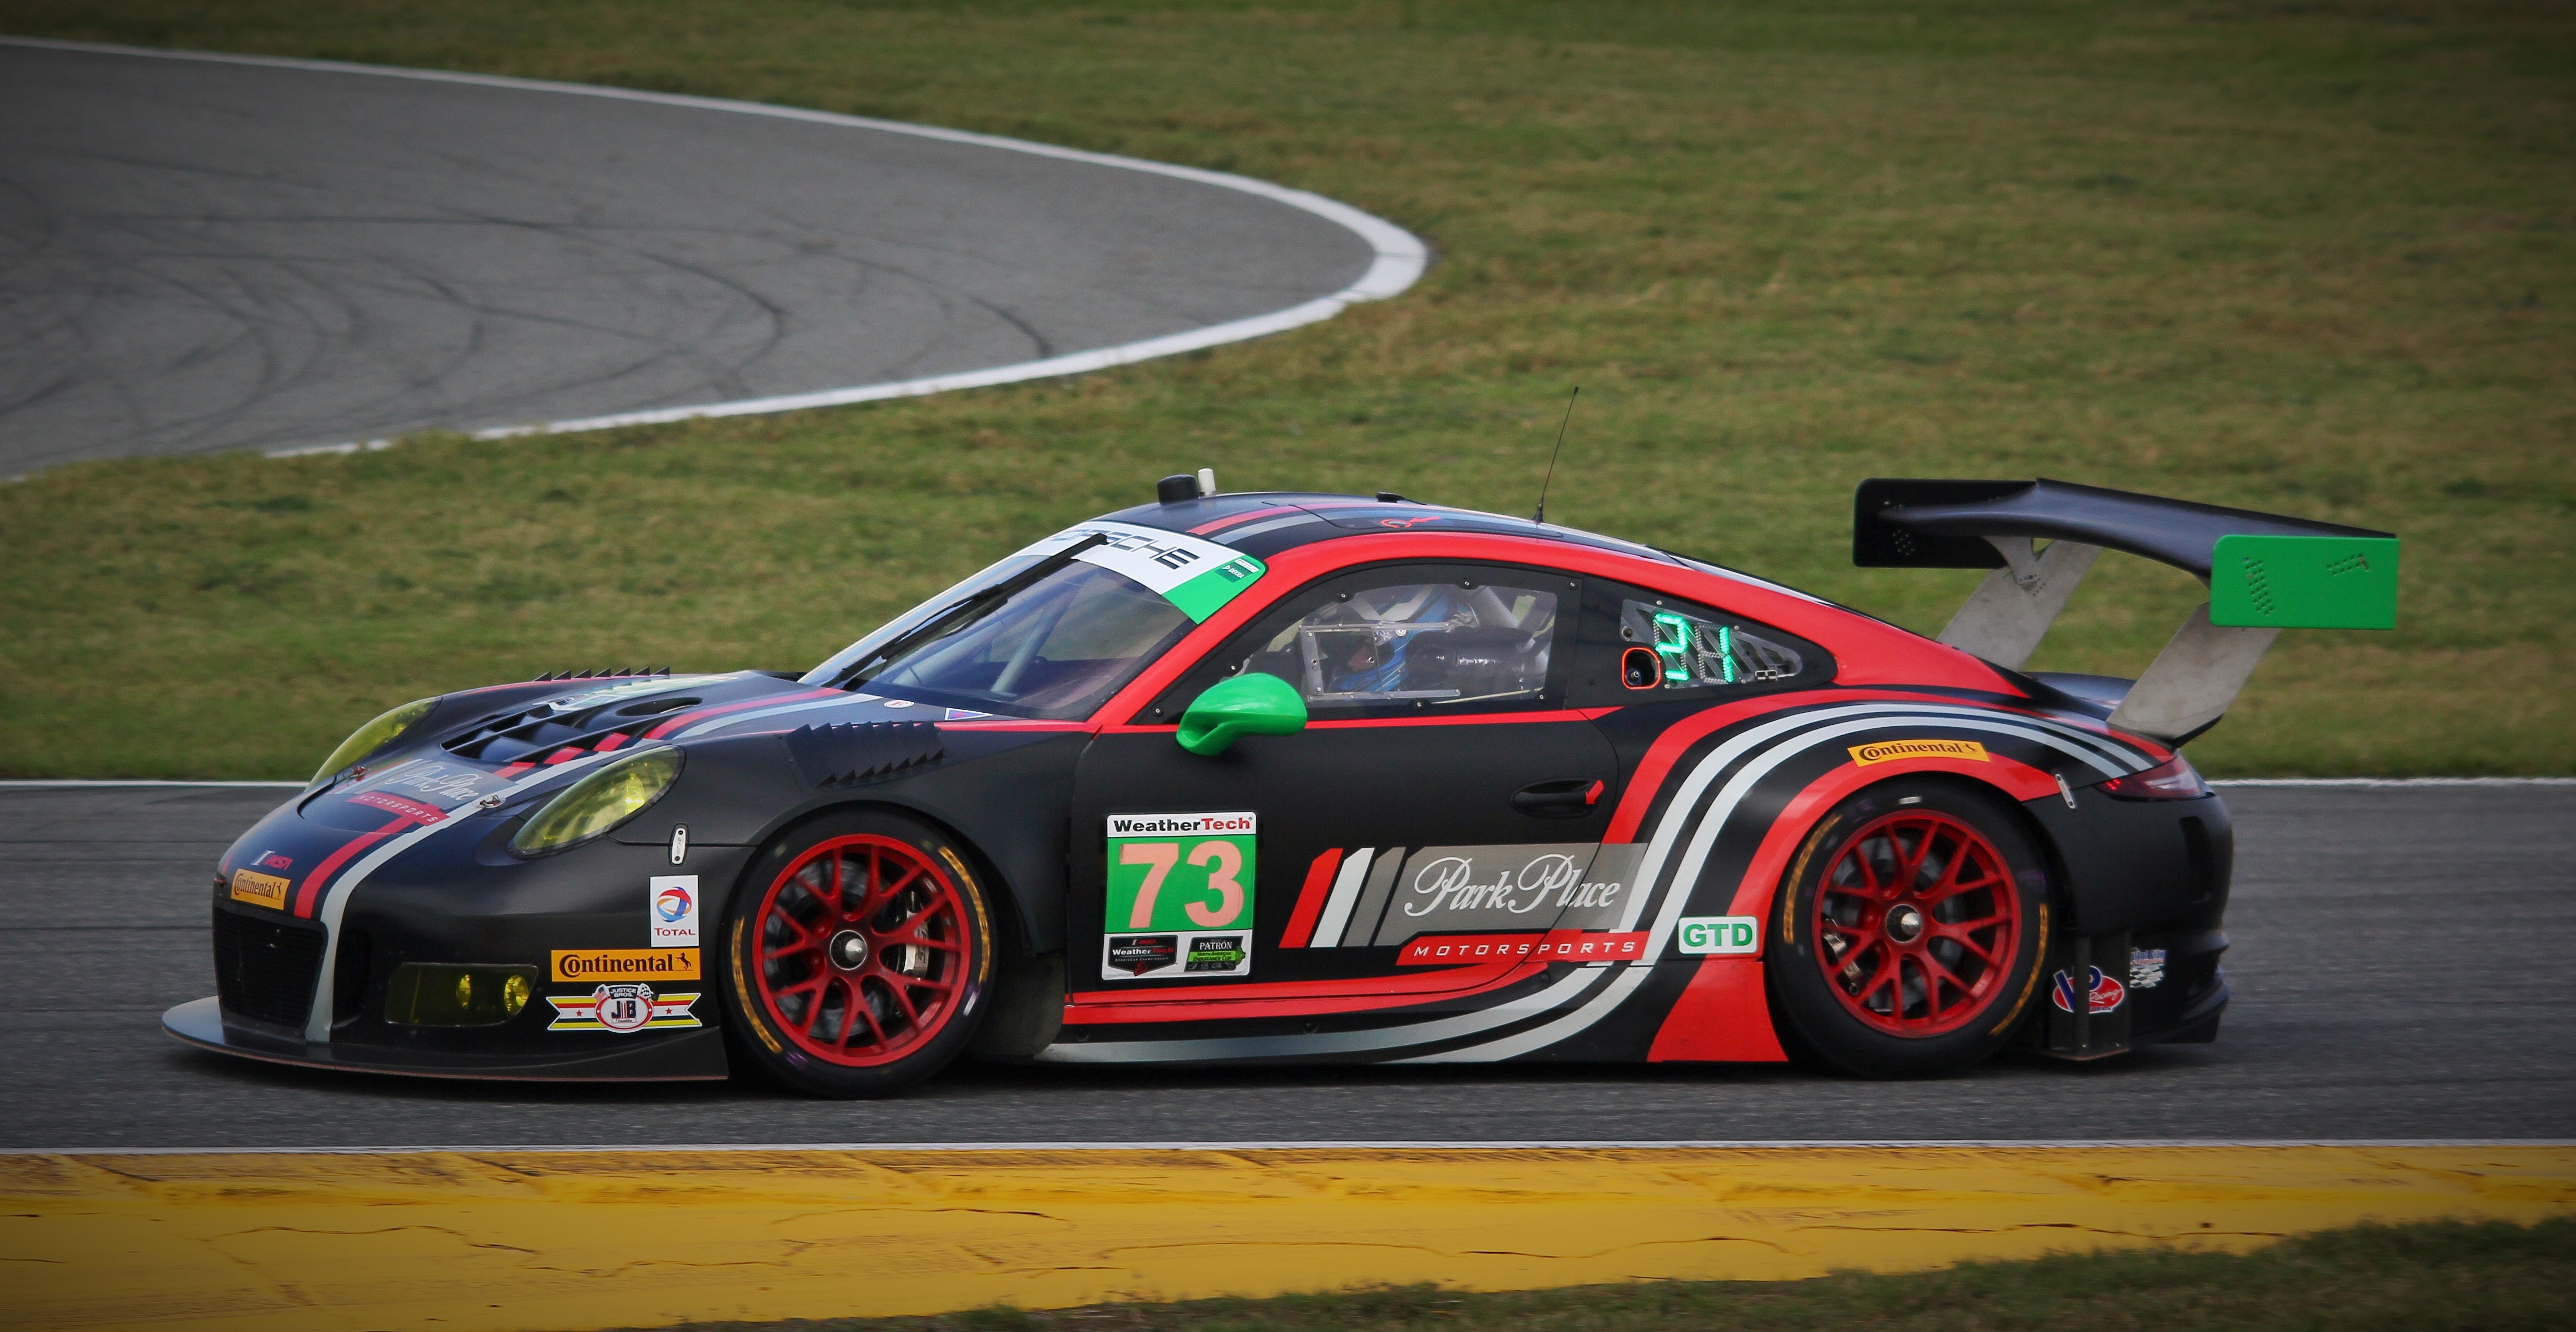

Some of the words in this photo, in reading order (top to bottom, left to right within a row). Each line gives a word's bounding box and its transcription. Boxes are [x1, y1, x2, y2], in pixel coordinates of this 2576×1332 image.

[1859, 742, 1963, 761] Continental
[358, 796, 439, 822] MOTORSPORTS
[1114, 817, 1251, 832] WeatherTech
[234, 873, 276, 898] Continental
[1119, 840, 1245, 929] 73
[1403, 855, 1514, 917] Park
[1507, 853, 1620, 914] Place
[654, 927, 696, 937] TOTAL
[1682, 923, 1754, 947] GTD
[1199, 940, 1233, 950] PATRÓN
[1413, 941, 1636, 957] MOTORSPORTS
[559, 953, 673, 978] Continental
